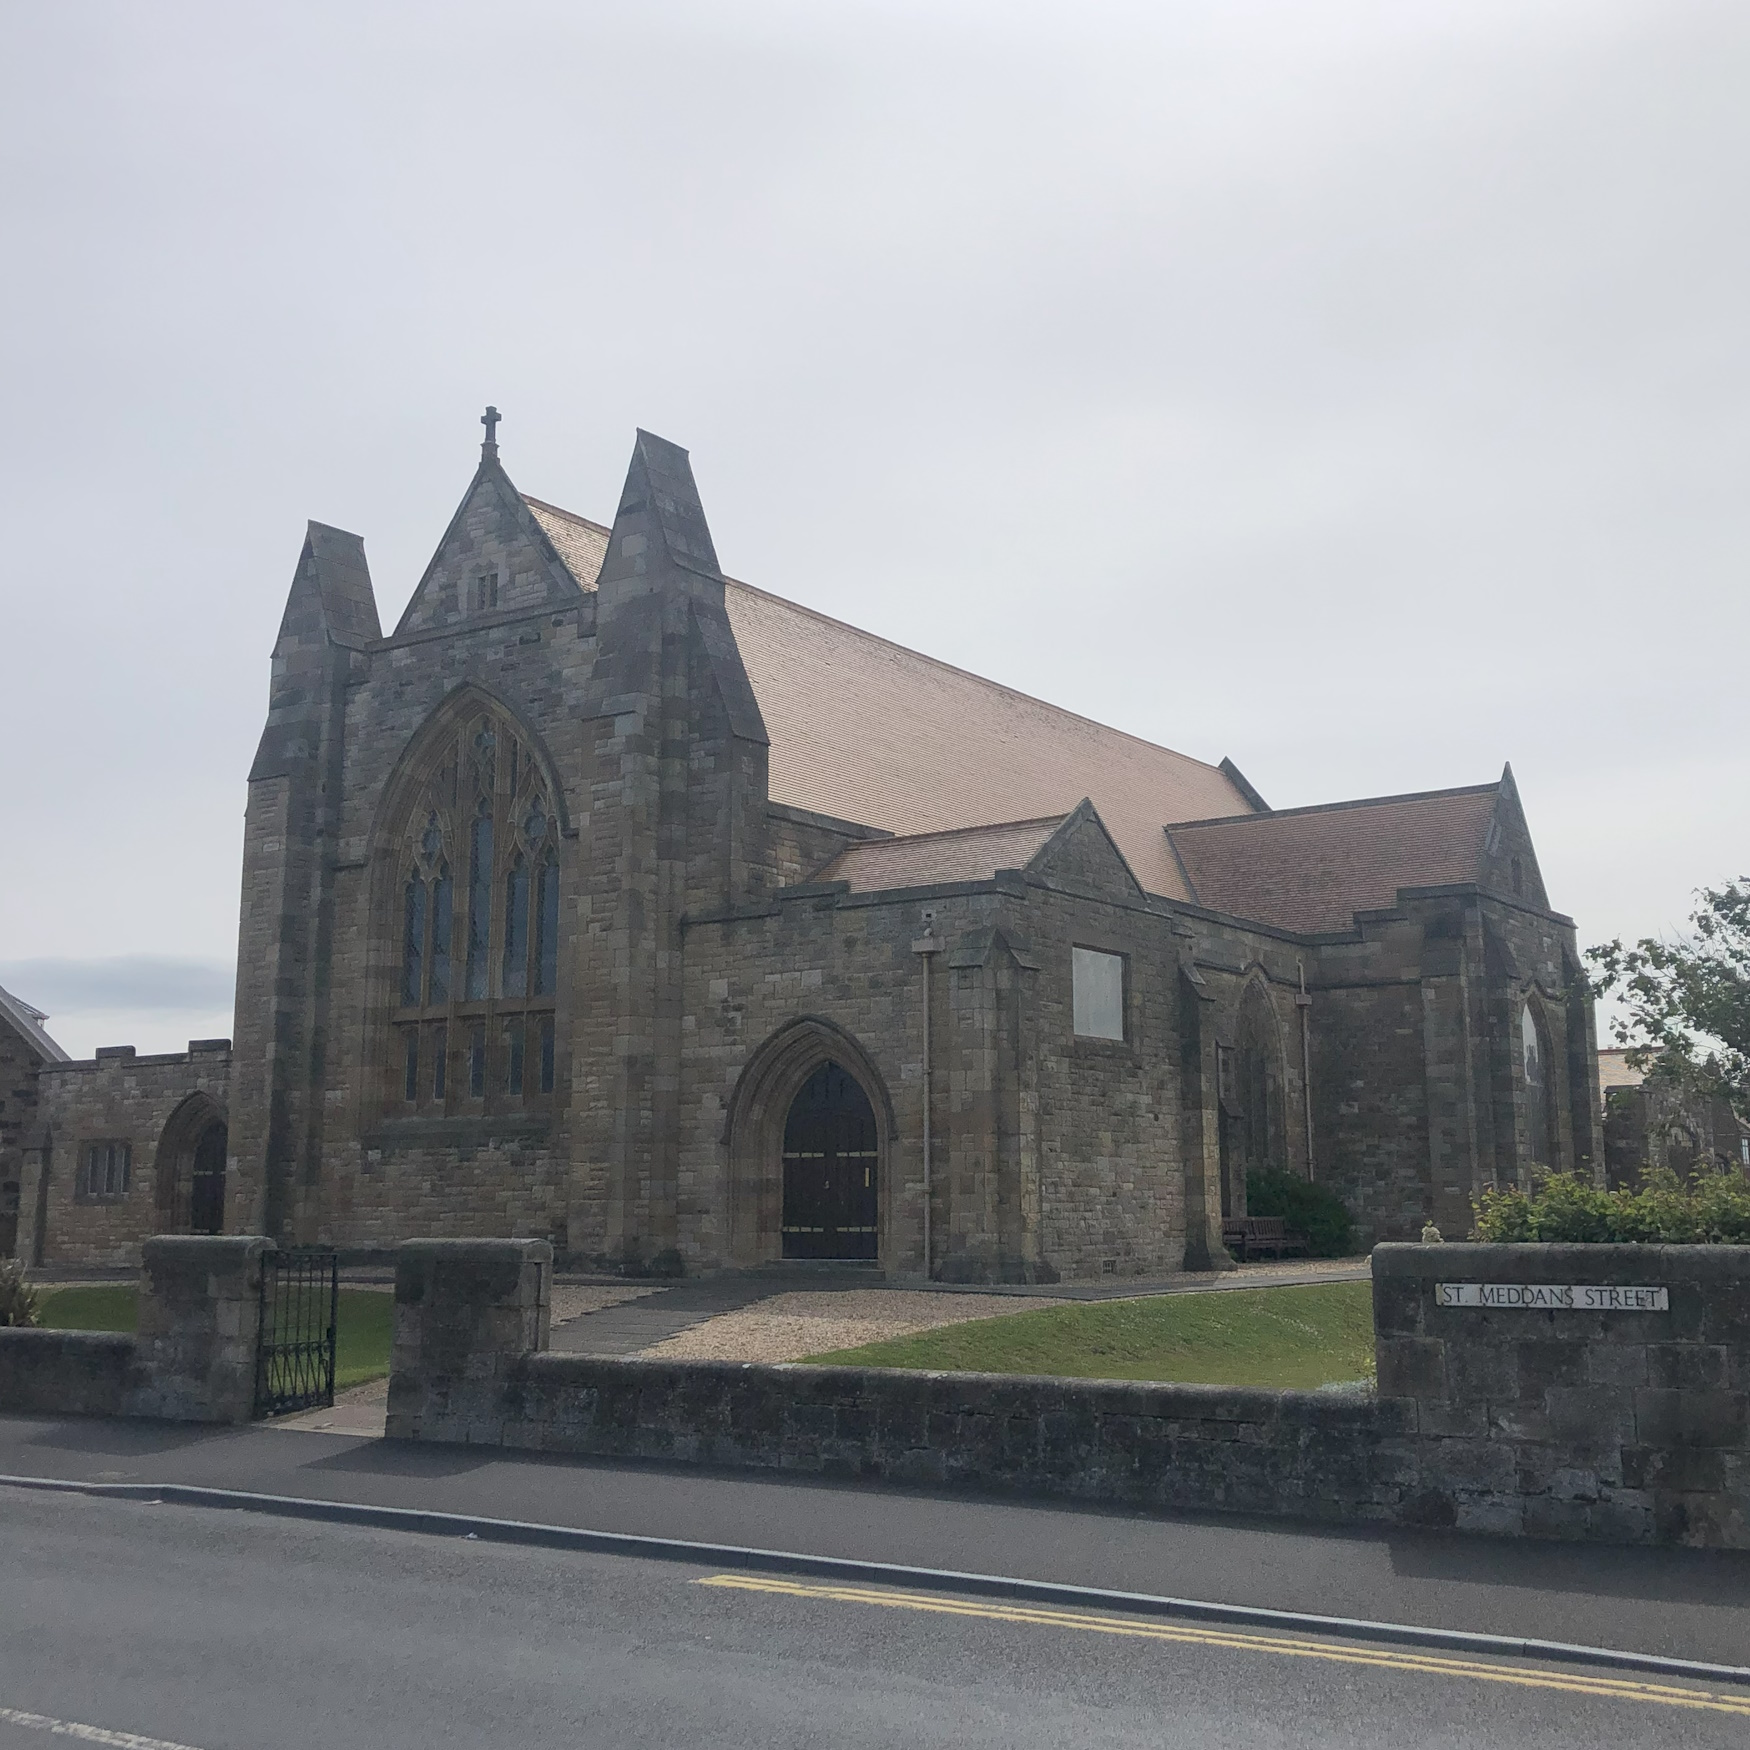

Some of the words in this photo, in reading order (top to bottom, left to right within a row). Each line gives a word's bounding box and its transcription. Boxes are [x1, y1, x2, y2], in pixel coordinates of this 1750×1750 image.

[1443, 1287, 1468, 1303] ST.
[1479, 1288, 1574, 1306] MEDDANS
[1585, 1289, 1659, 1307] STREET
